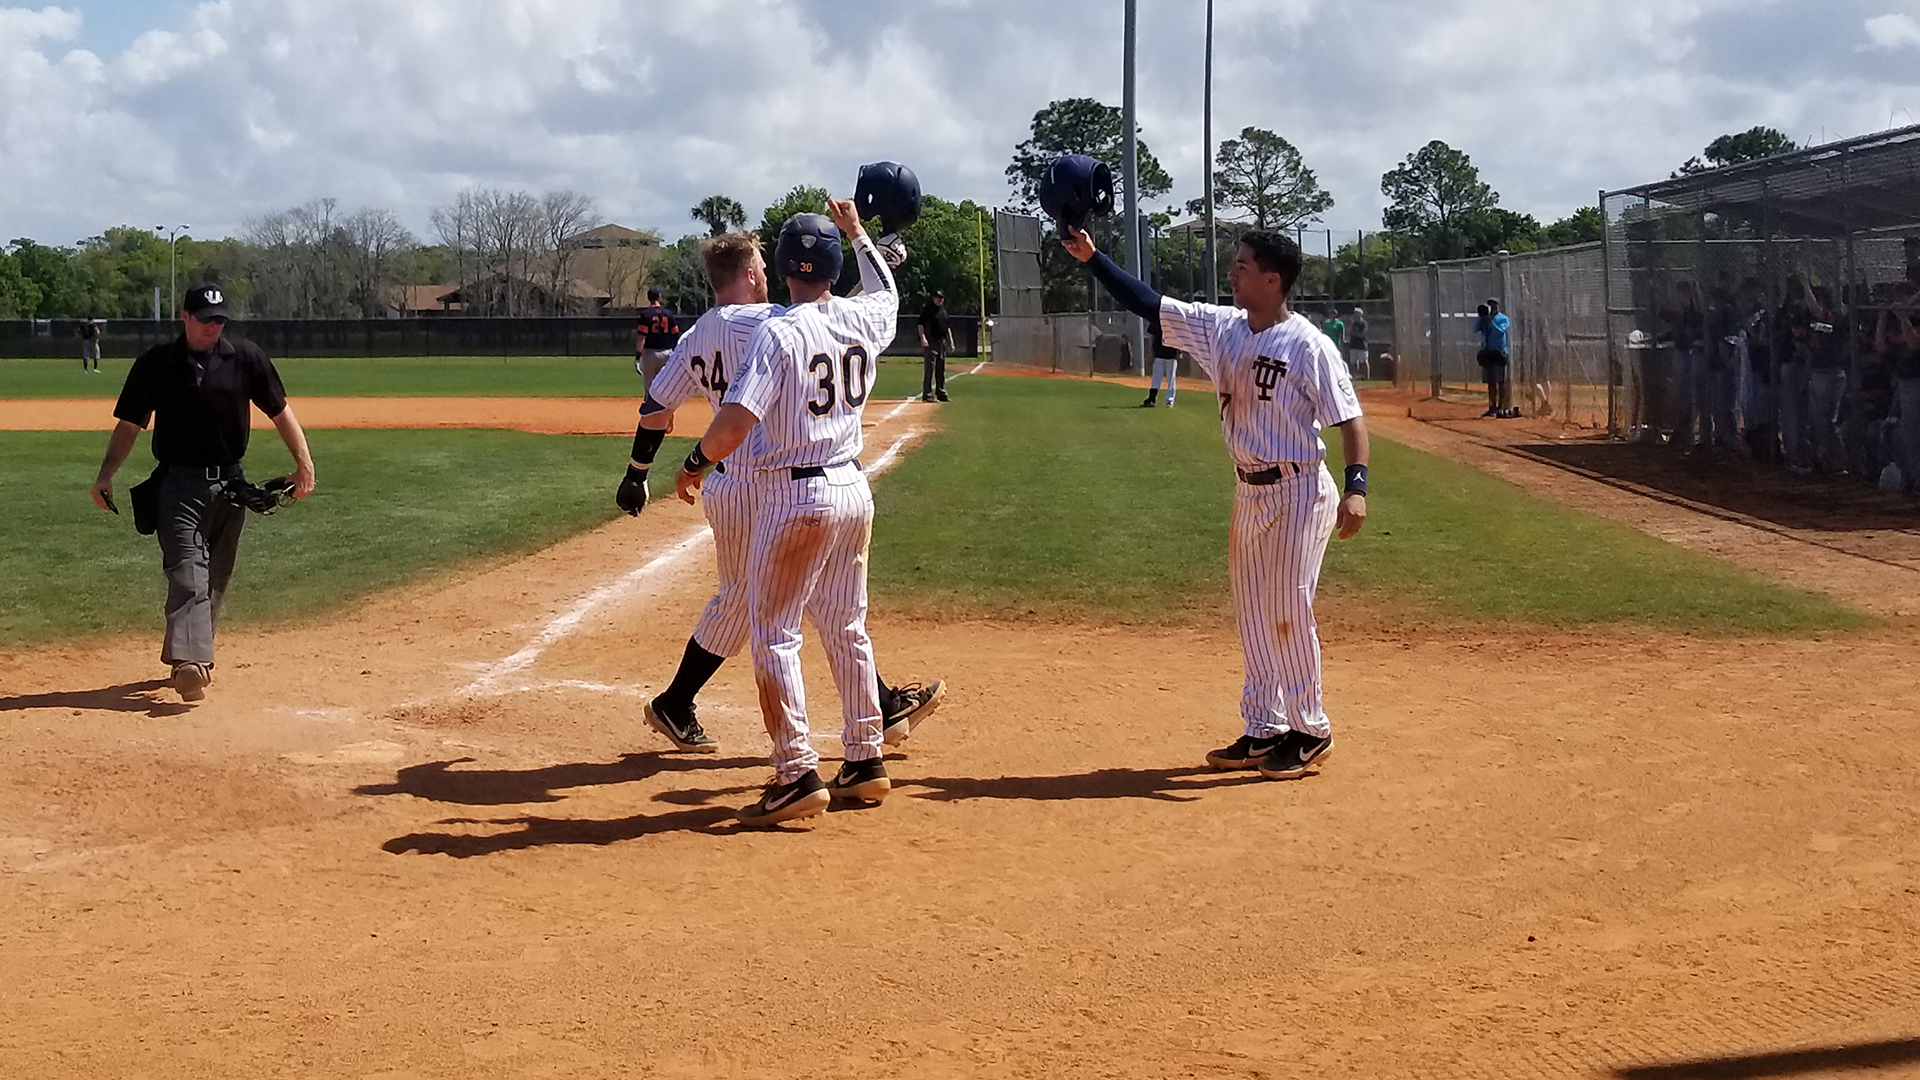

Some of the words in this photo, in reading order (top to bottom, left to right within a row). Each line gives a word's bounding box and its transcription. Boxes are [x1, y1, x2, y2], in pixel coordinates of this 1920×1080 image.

[800, 262, 813, 273] 30
[651, 315, 669, 333] 24
[807, 343, 867, 419] 30
